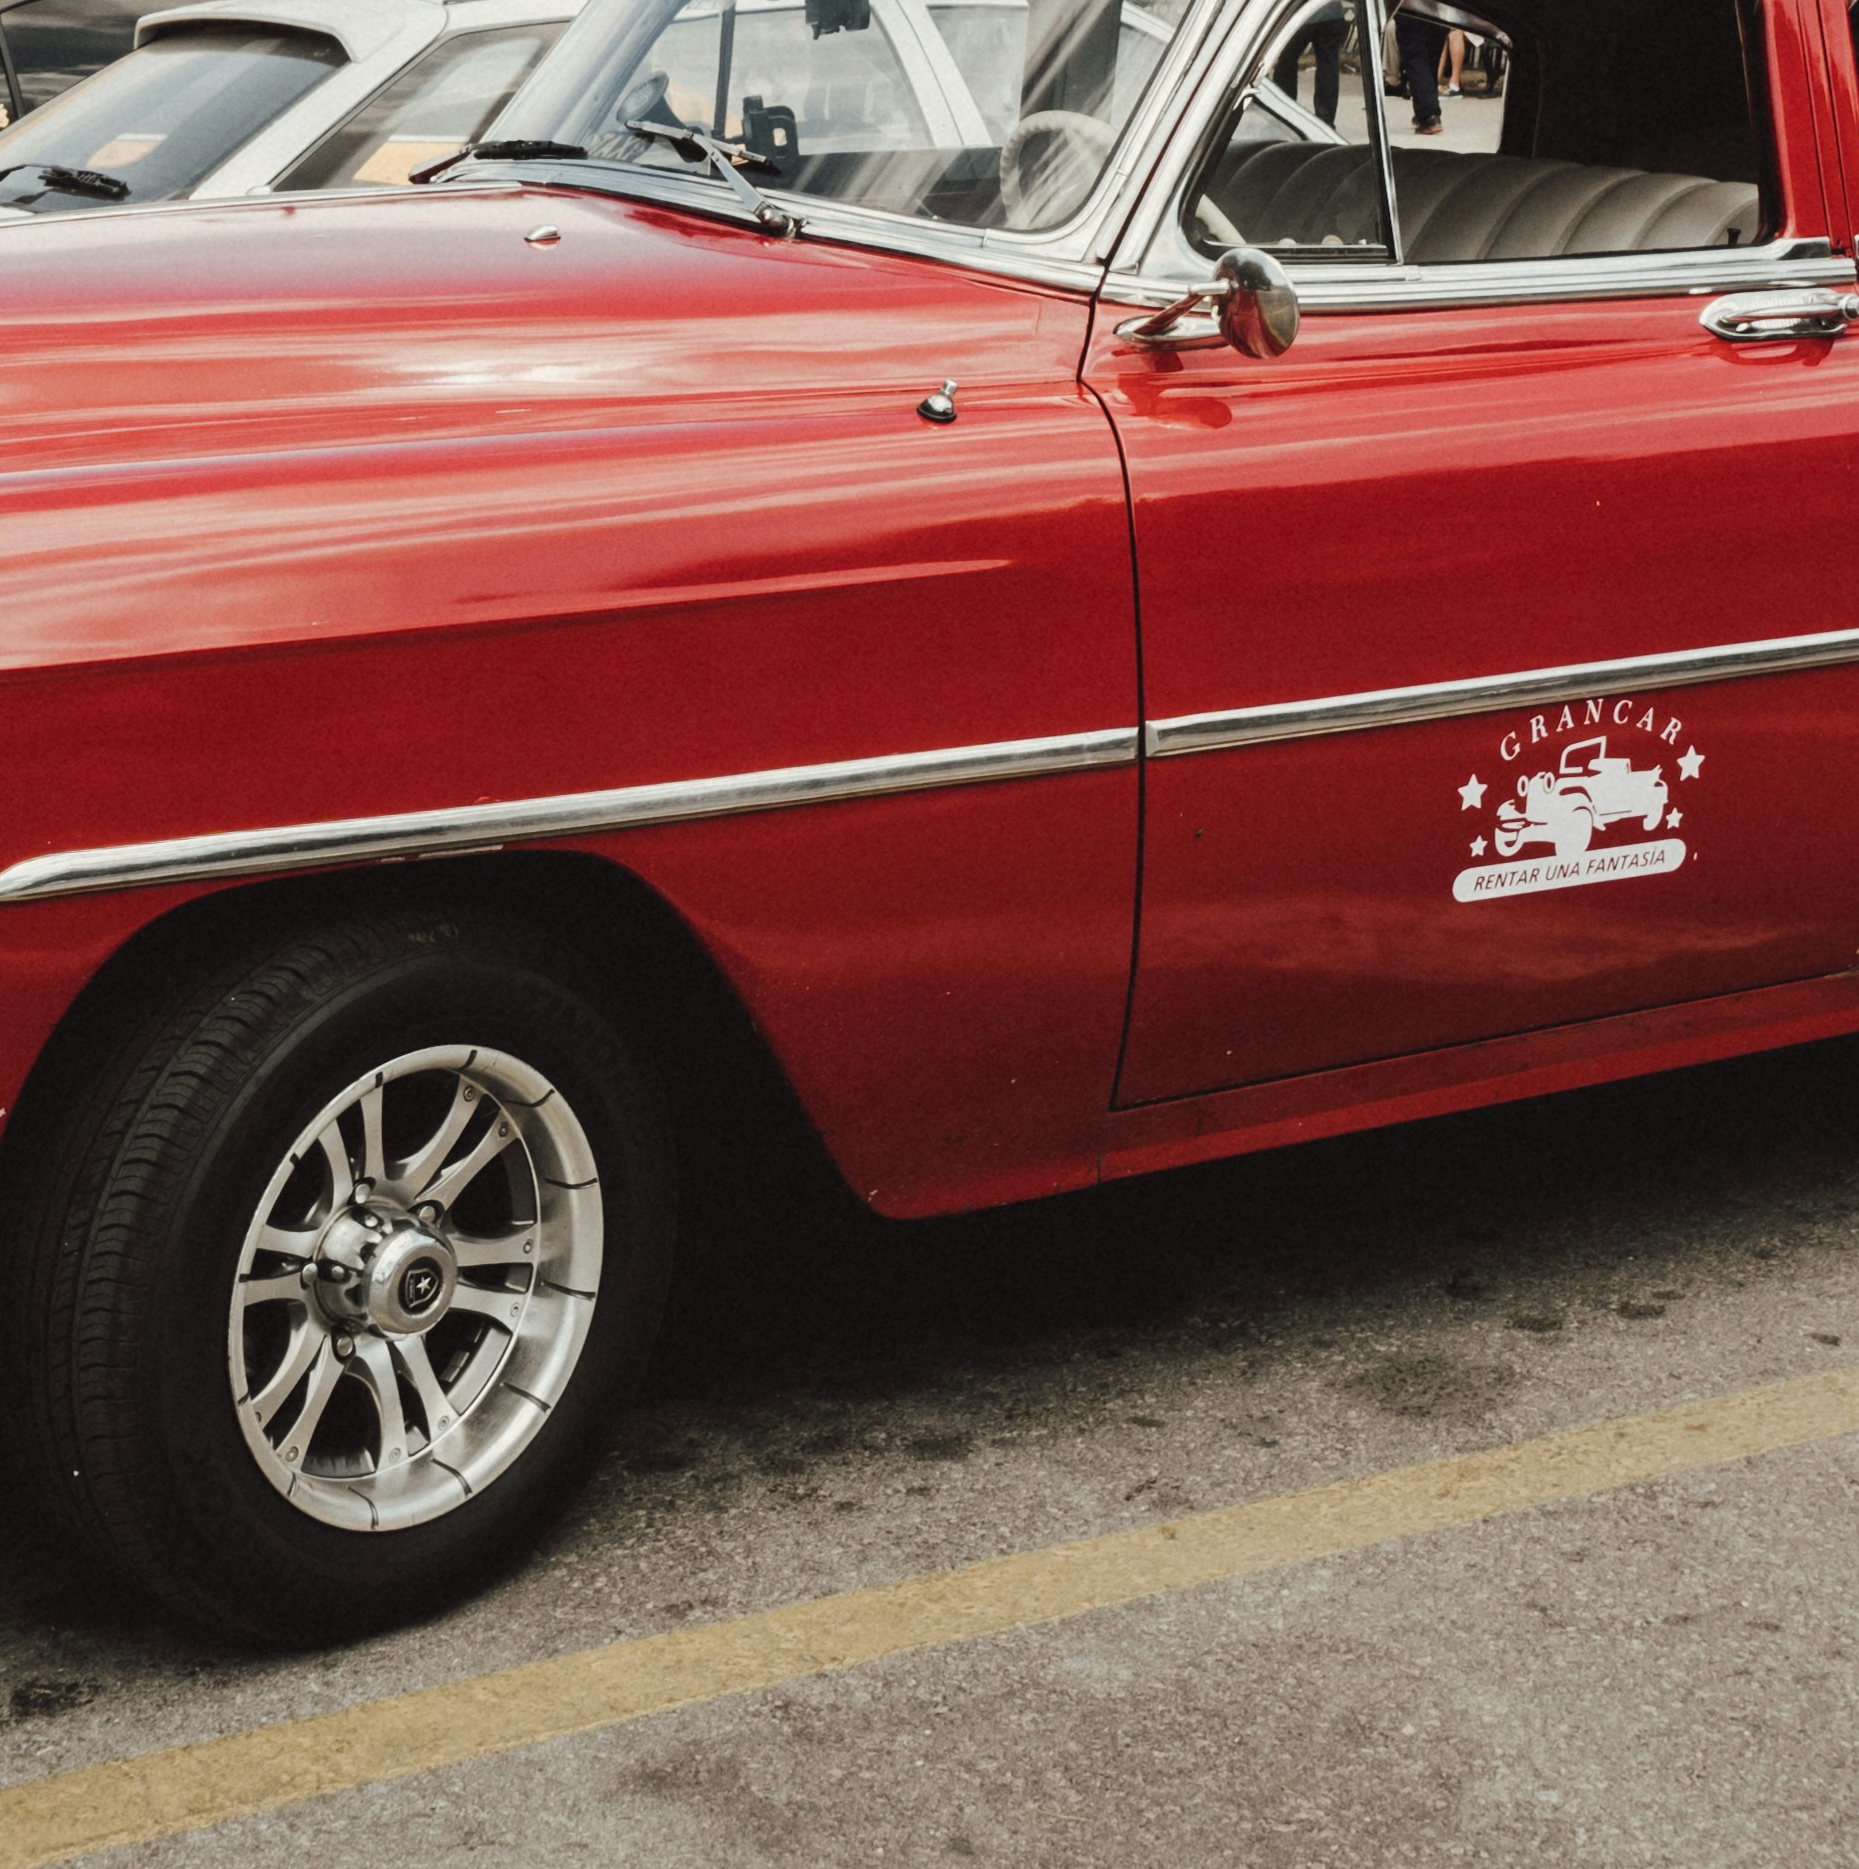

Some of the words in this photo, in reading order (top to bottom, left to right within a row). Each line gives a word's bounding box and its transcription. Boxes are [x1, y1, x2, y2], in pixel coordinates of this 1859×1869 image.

[1500, 698, 1682, 761] GRANCAR
[1473, 867, 1540, 892] RENTAR
[1545, 862, 1581, 881] UNA
[1585, 846, 1666, 875] FANTASÍA
